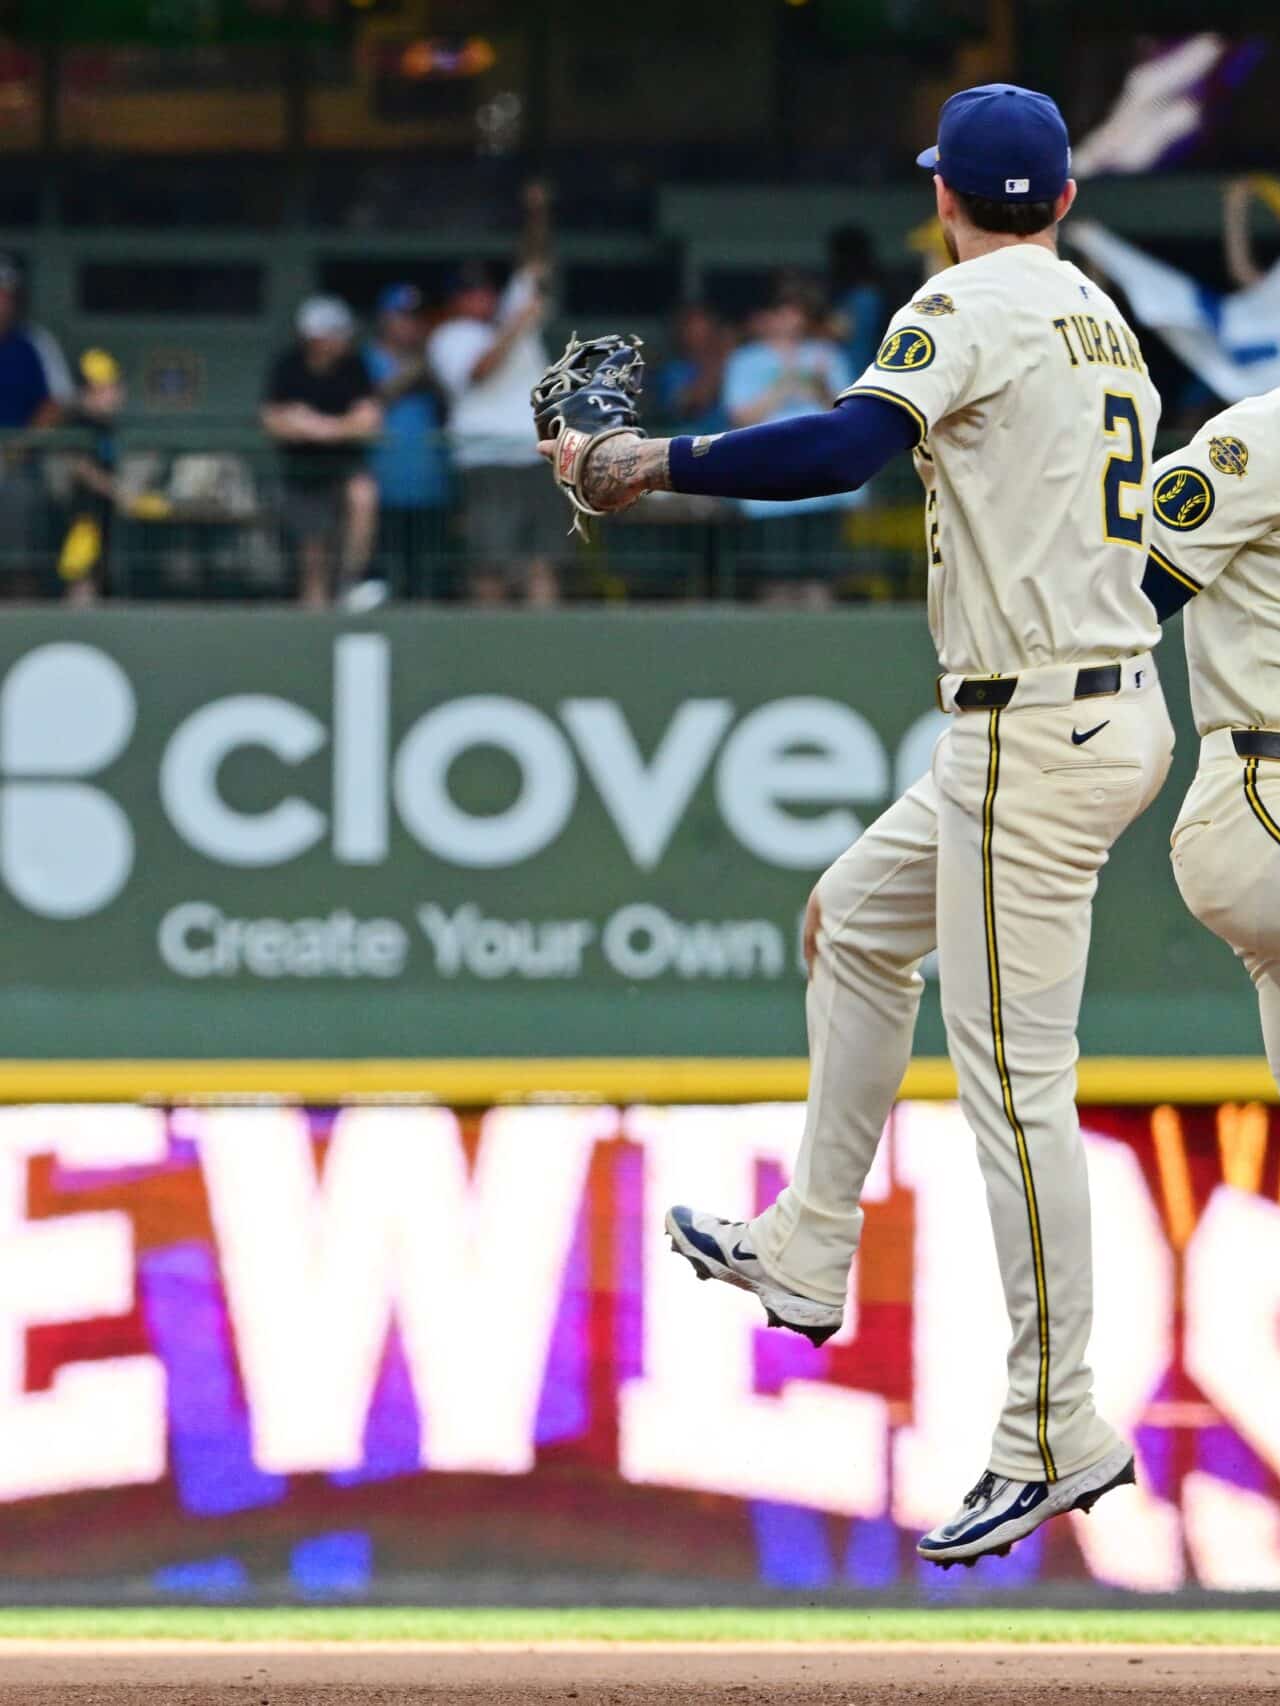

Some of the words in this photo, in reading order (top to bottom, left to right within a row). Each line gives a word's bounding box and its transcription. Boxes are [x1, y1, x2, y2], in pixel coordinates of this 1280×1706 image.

[1102, 388, 1145, 549] 2
[159, 631, 953, 871] clove
[157, 901, 408, 980] Create
[416, 901, 596, 980] Your
[604, 901, 786, 981] Own
